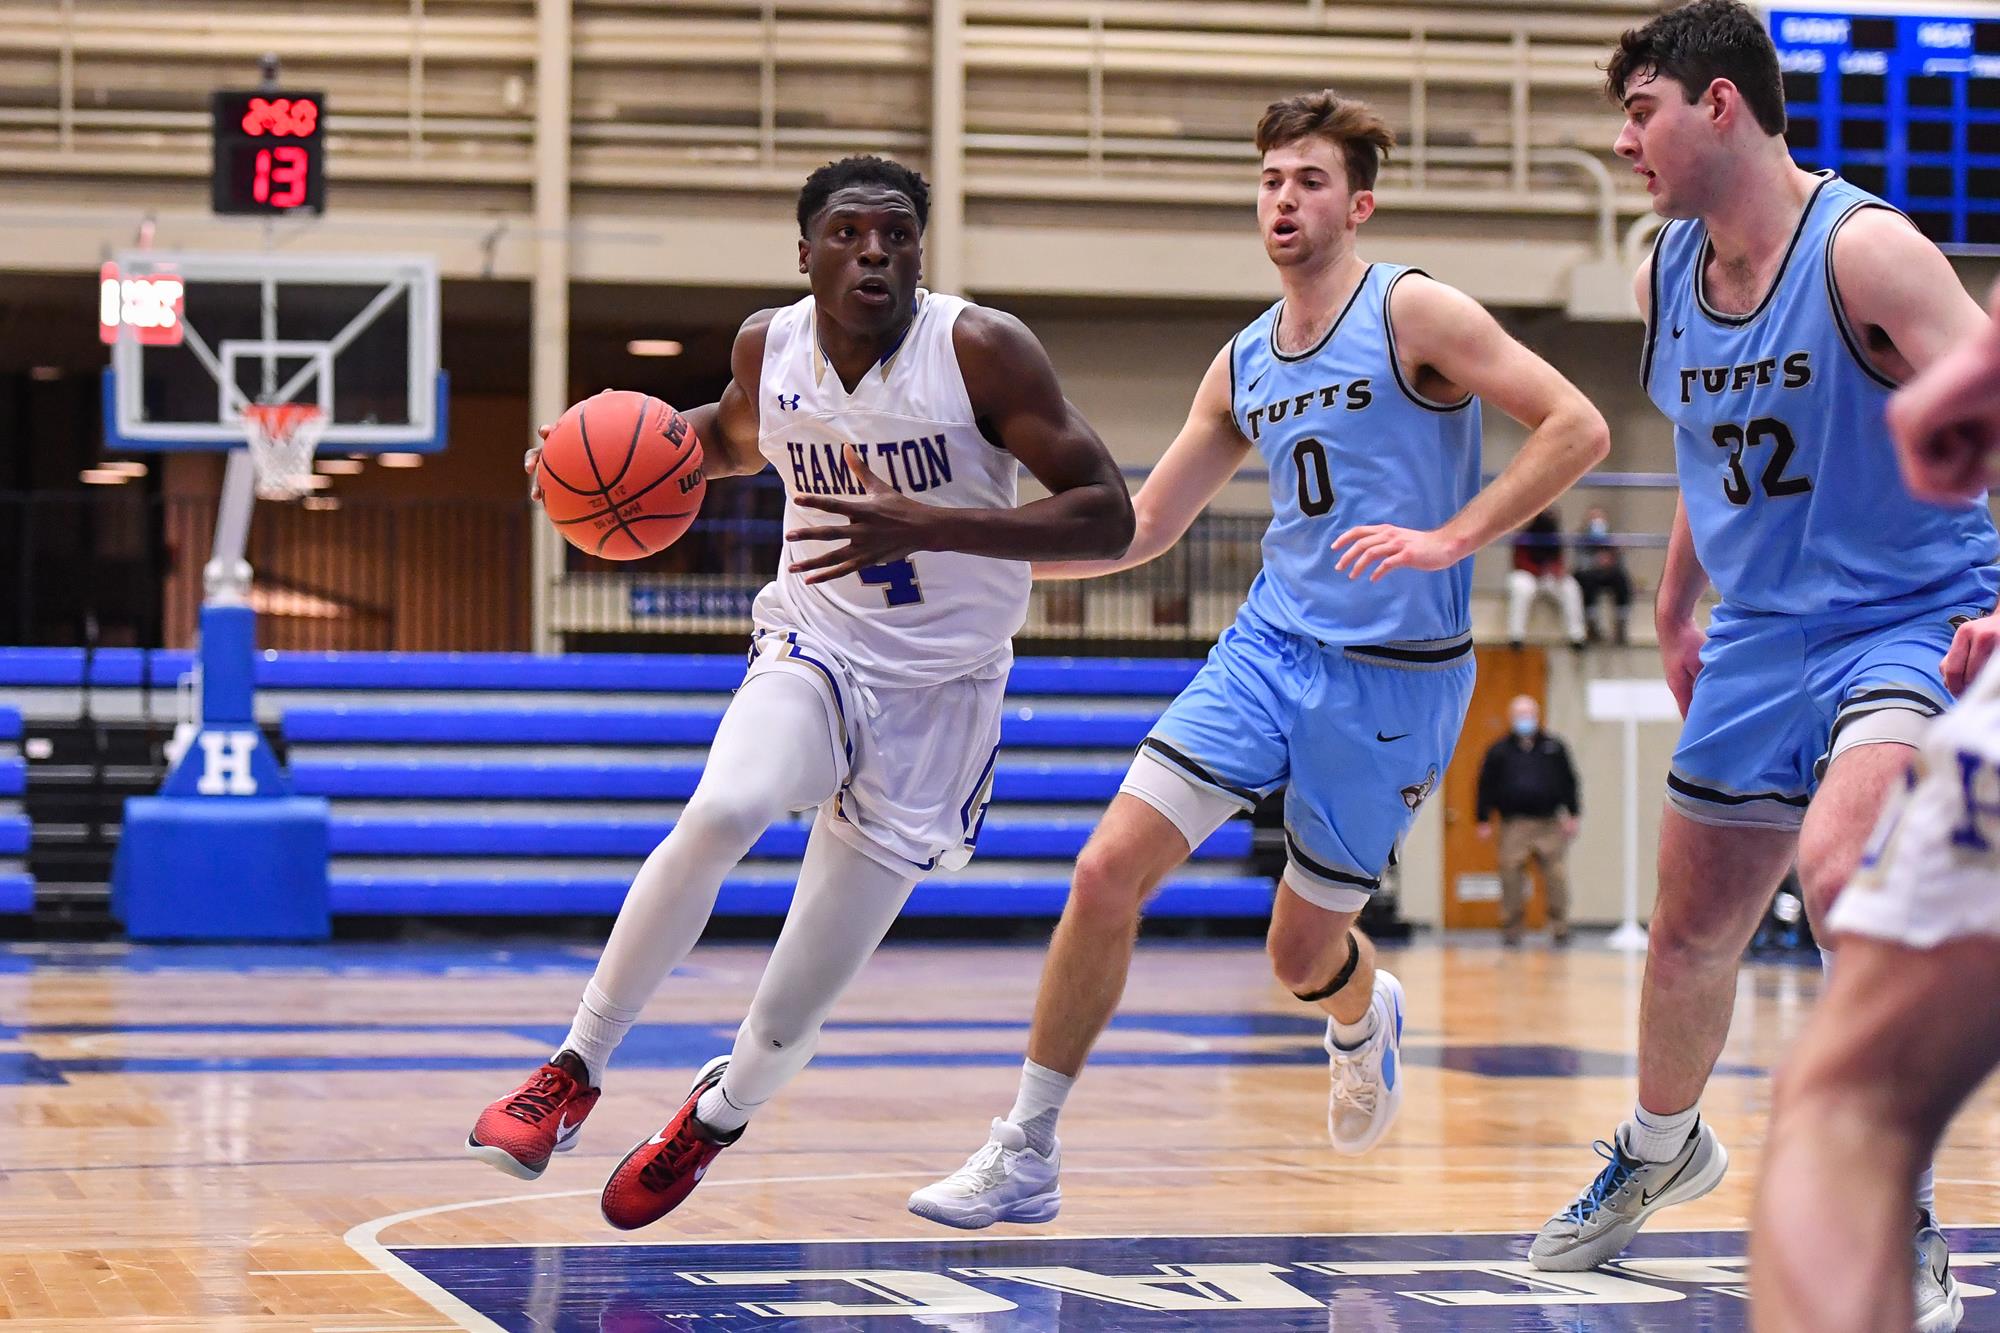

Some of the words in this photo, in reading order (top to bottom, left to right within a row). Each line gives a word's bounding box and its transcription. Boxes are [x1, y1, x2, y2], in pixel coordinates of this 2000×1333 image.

[253, 145, 309, 208] 13
[1679, 350, 1812, 405] TUFTS
[1247, 378, 1373, 442] TUFTS
[1293, 437, 1335, 519] 0
[1712, 417, 1812, 506] 32
[197, 731, 259, 795] H
